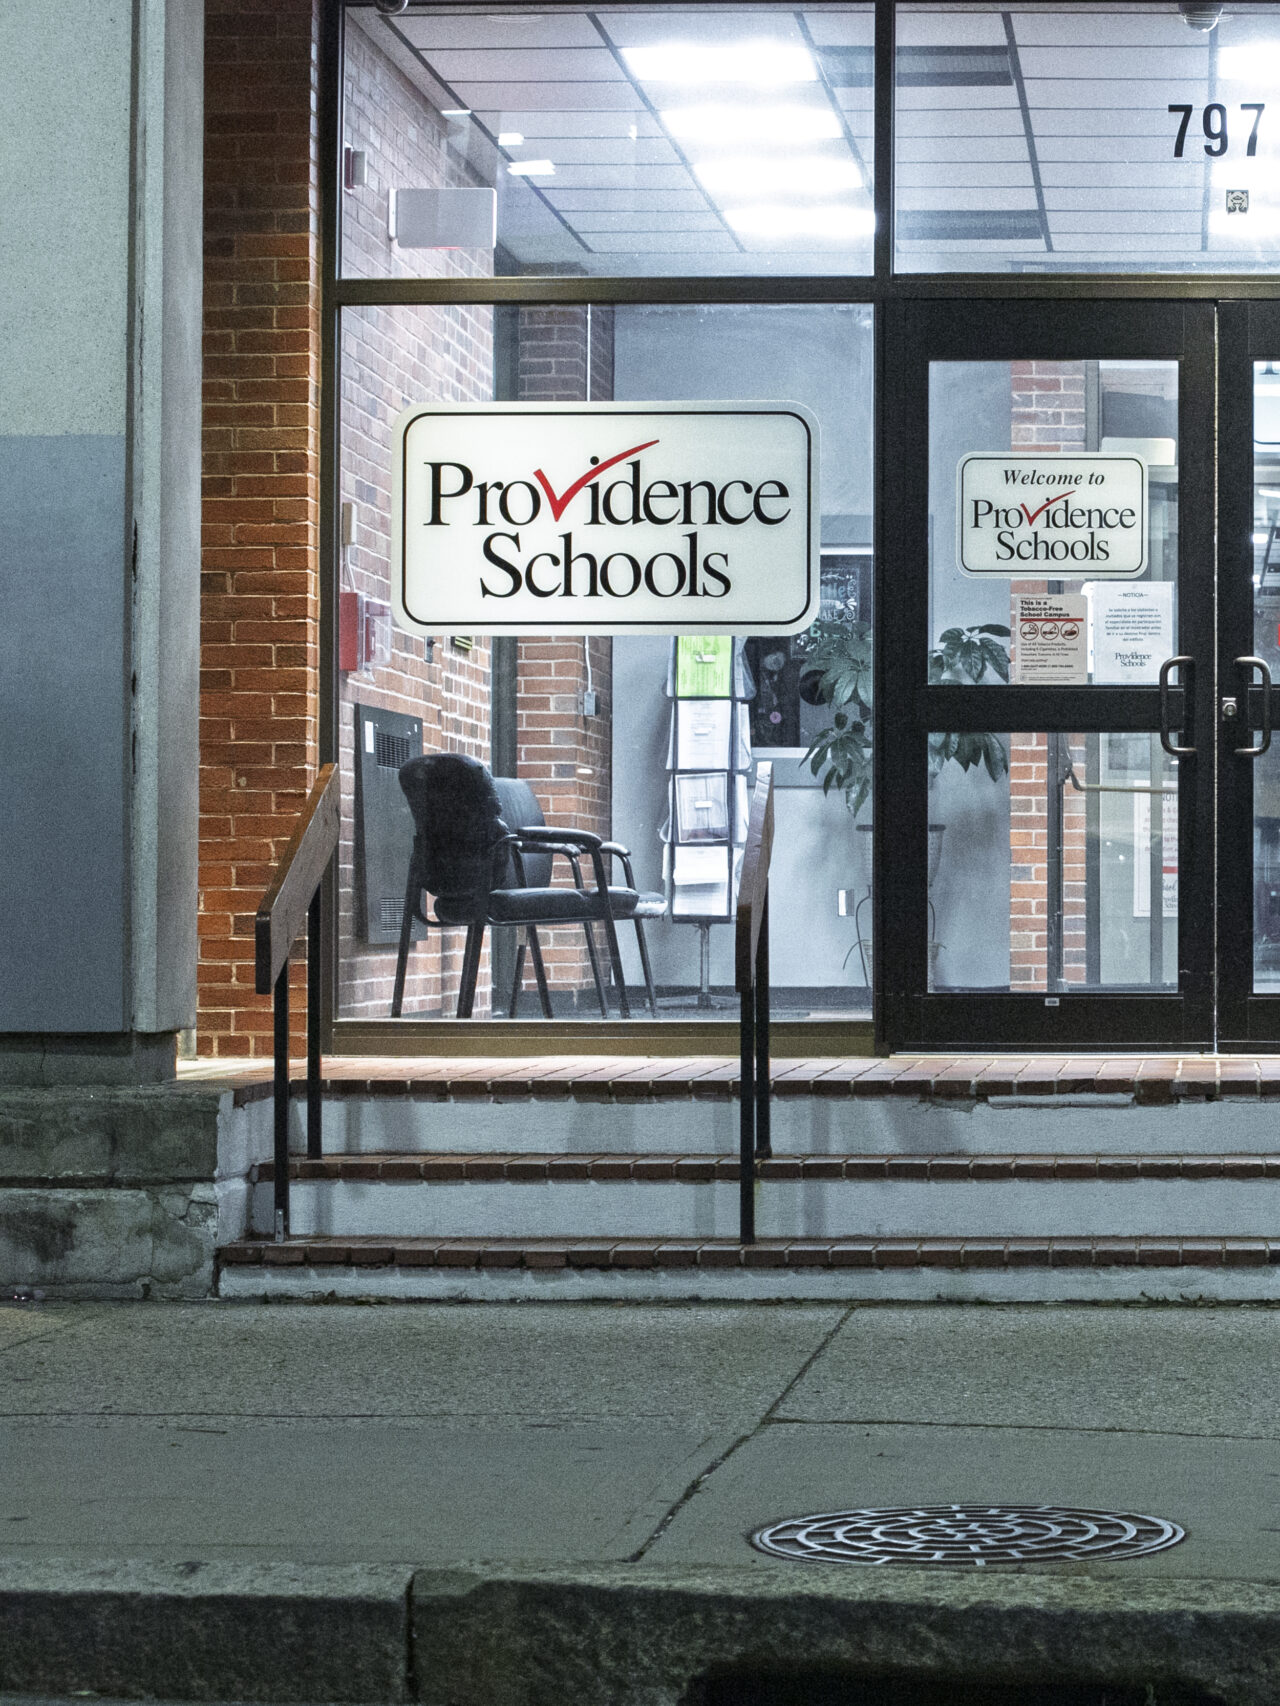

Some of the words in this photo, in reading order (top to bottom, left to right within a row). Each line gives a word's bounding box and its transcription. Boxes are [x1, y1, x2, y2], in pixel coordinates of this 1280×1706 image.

[1168, 103, 1265, 158] 797
[423, 440, 791, 526] Providence
[1004, 469, 1083, 485] Welcome
[1088, 472, 1105, 485] to
[971, 491, 1136, 529] Providence
[479, 531, 732, 598] Schools
[995, 531, 1110, 561] Schools
